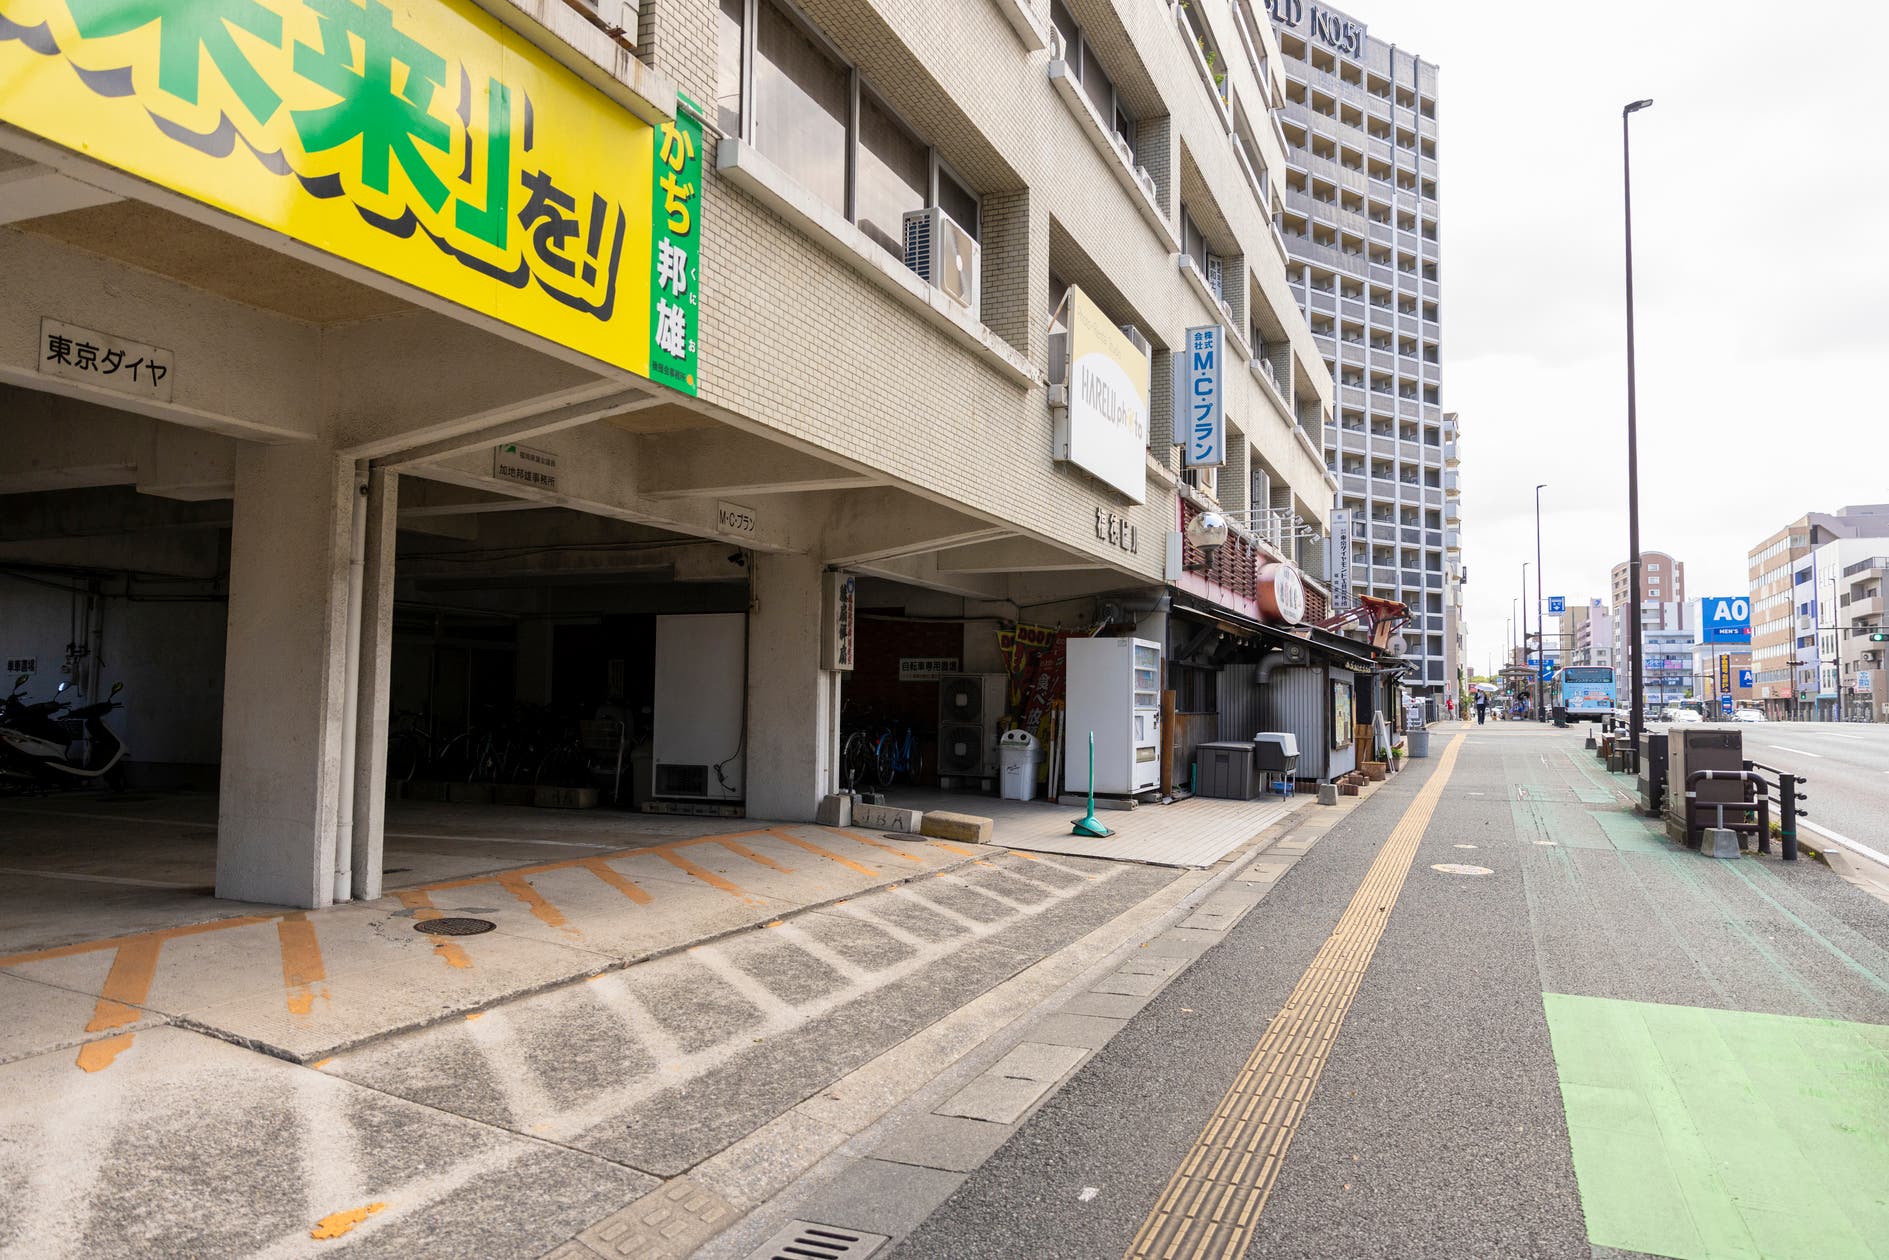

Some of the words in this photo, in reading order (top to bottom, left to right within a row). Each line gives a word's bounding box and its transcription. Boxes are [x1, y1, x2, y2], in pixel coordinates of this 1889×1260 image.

[1265, 0, 1304, 27] LD
[46, 333, 168, 387] 東京ダイヤ
